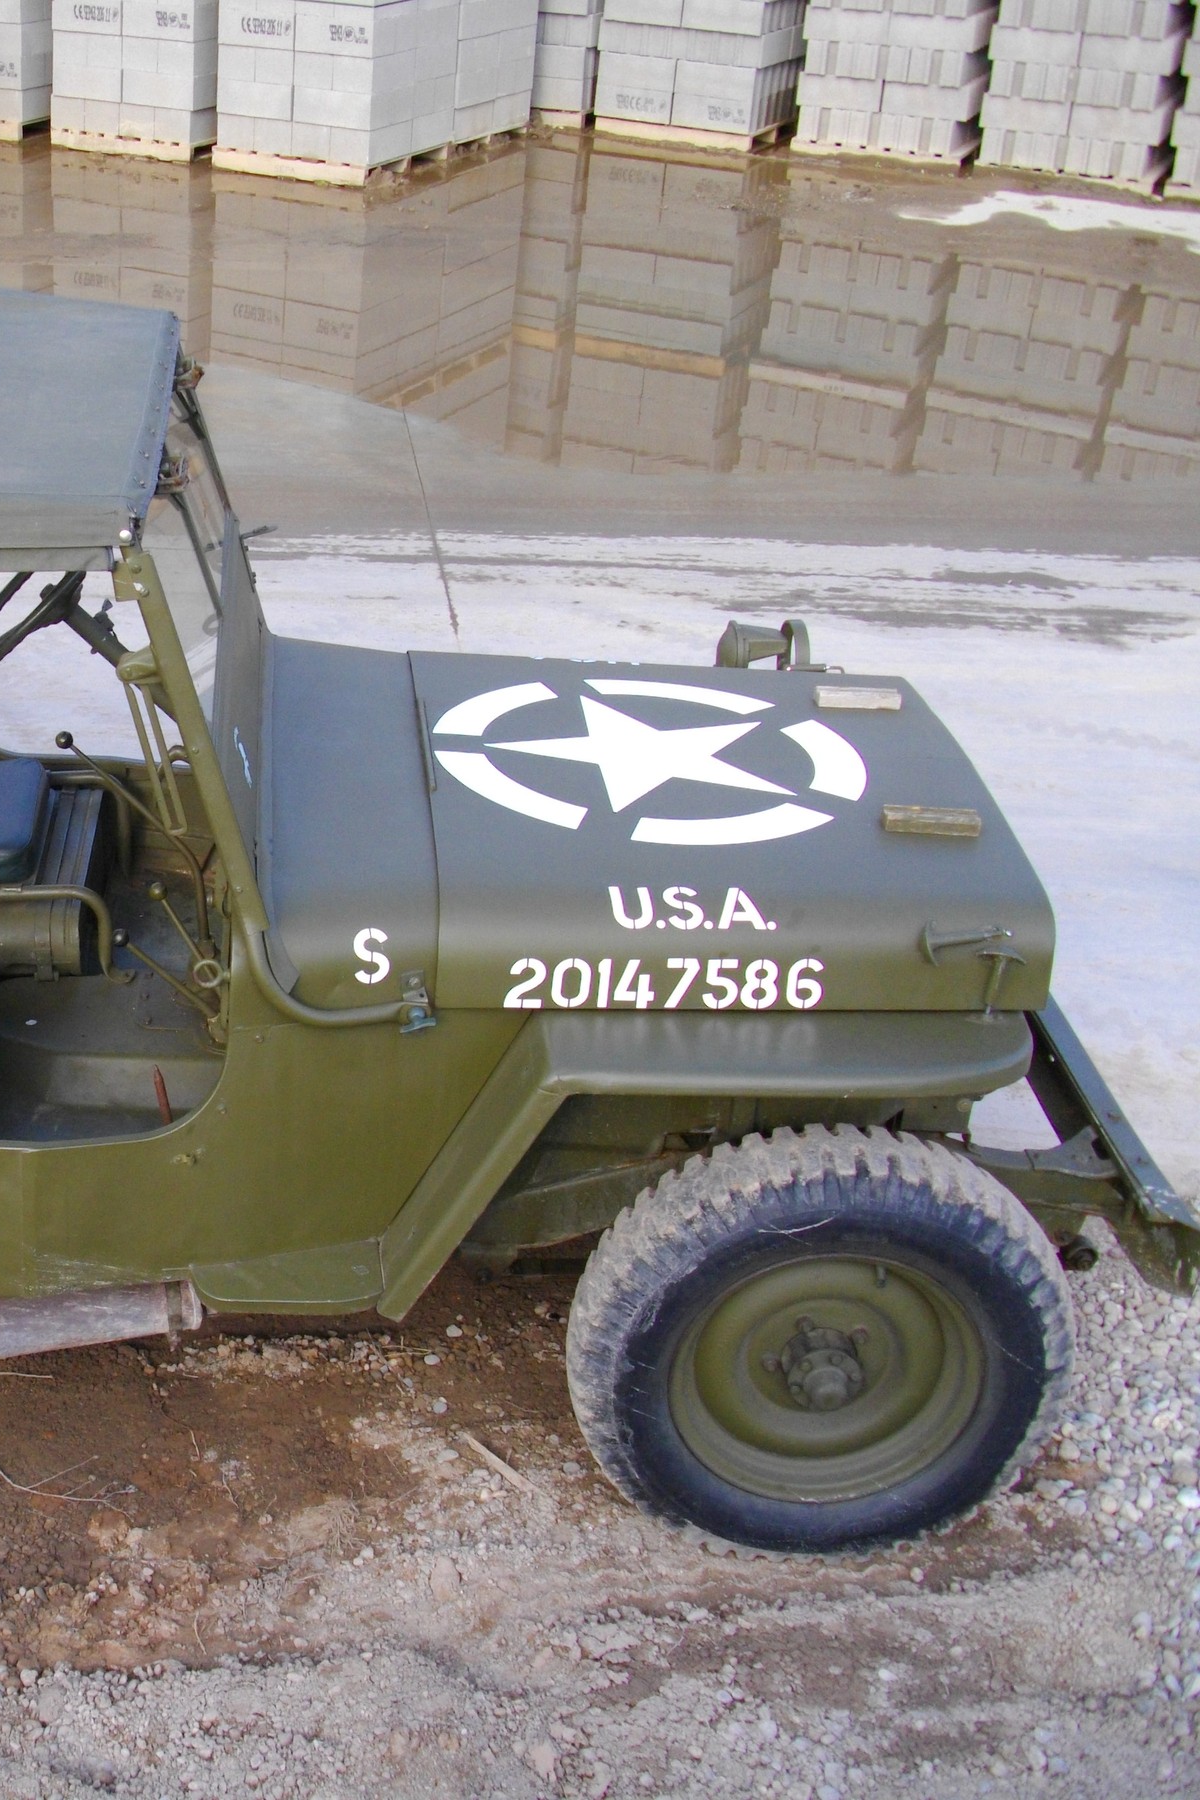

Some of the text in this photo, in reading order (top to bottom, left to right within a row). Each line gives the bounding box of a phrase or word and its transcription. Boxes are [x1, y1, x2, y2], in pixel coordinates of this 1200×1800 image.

[607, 885, 777, 931] U.S.A.
[353, 928, 390, 984] S
[503, 957, 824, 1010] 20147586
